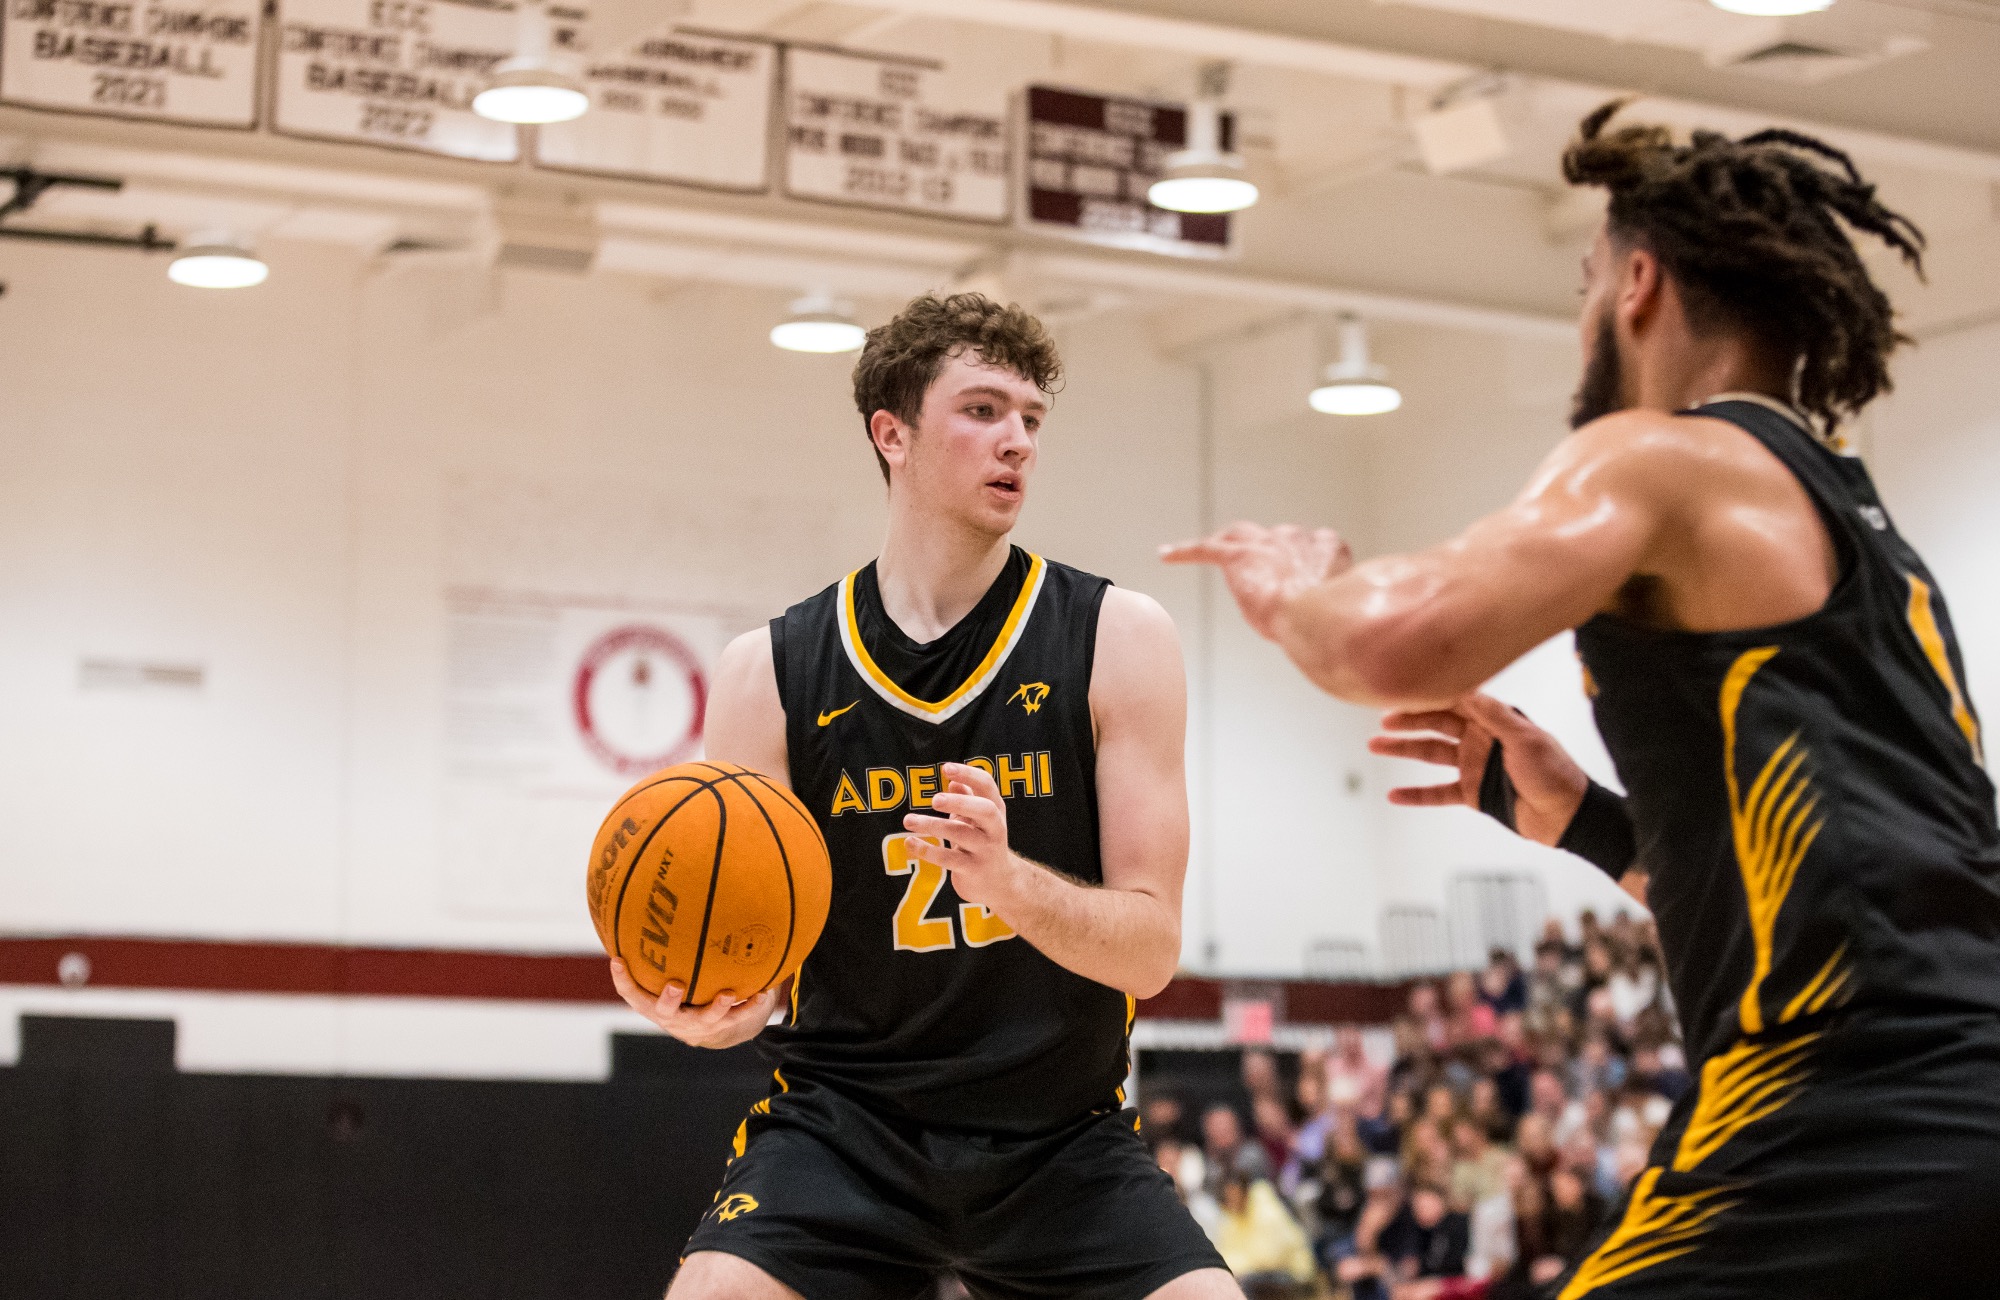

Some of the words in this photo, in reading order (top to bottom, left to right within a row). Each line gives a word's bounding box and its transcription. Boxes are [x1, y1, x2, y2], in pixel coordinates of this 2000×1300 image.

[34, 29, 225, 79] BASEBALL
[657, 846, 675, 880] NXT
[640, 879, 679, 974] EVO
